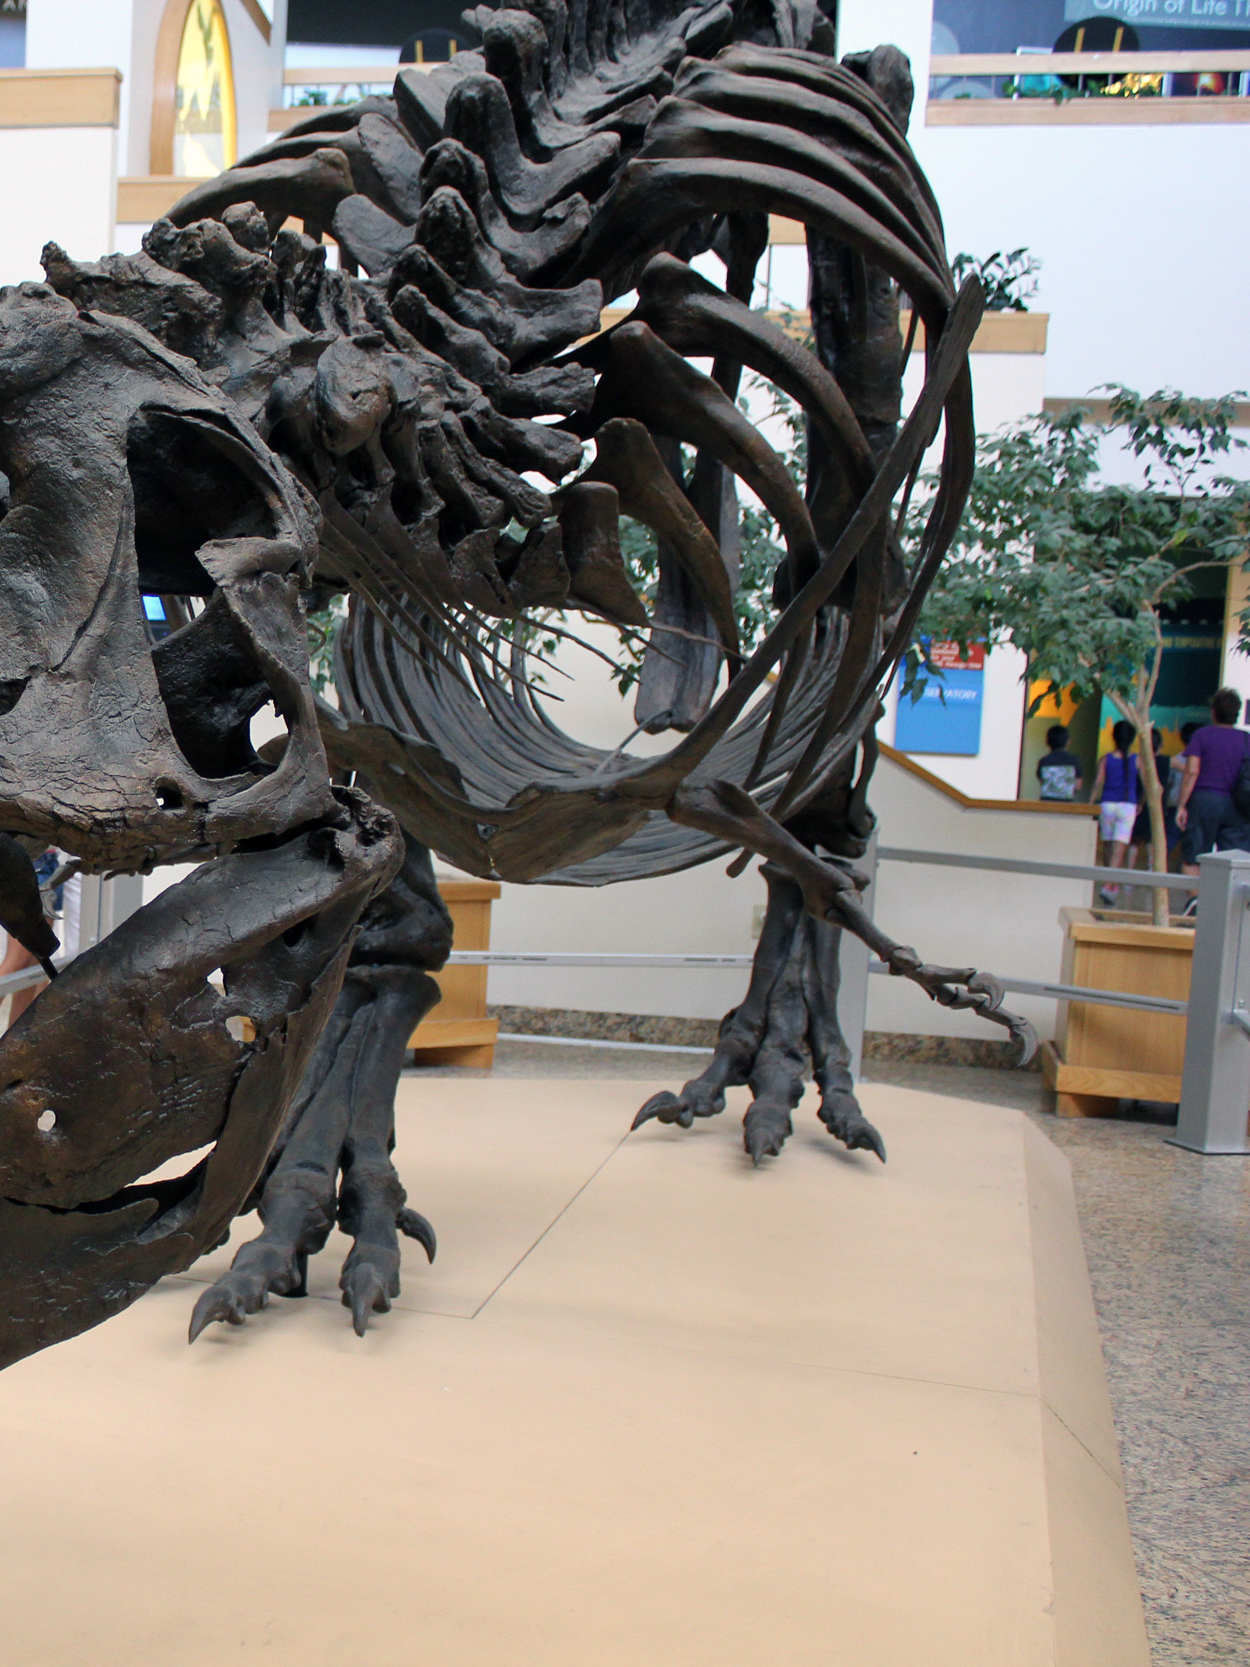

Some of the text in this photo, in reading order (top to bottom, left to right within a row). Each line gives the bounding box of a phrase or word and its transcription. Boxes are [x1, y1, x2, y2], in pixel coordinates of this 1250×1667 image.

[1092, 0, 1157, 17] Origin
[1164, 0, 1187, 14] of
[1191, 0, 1227, 16] Life
